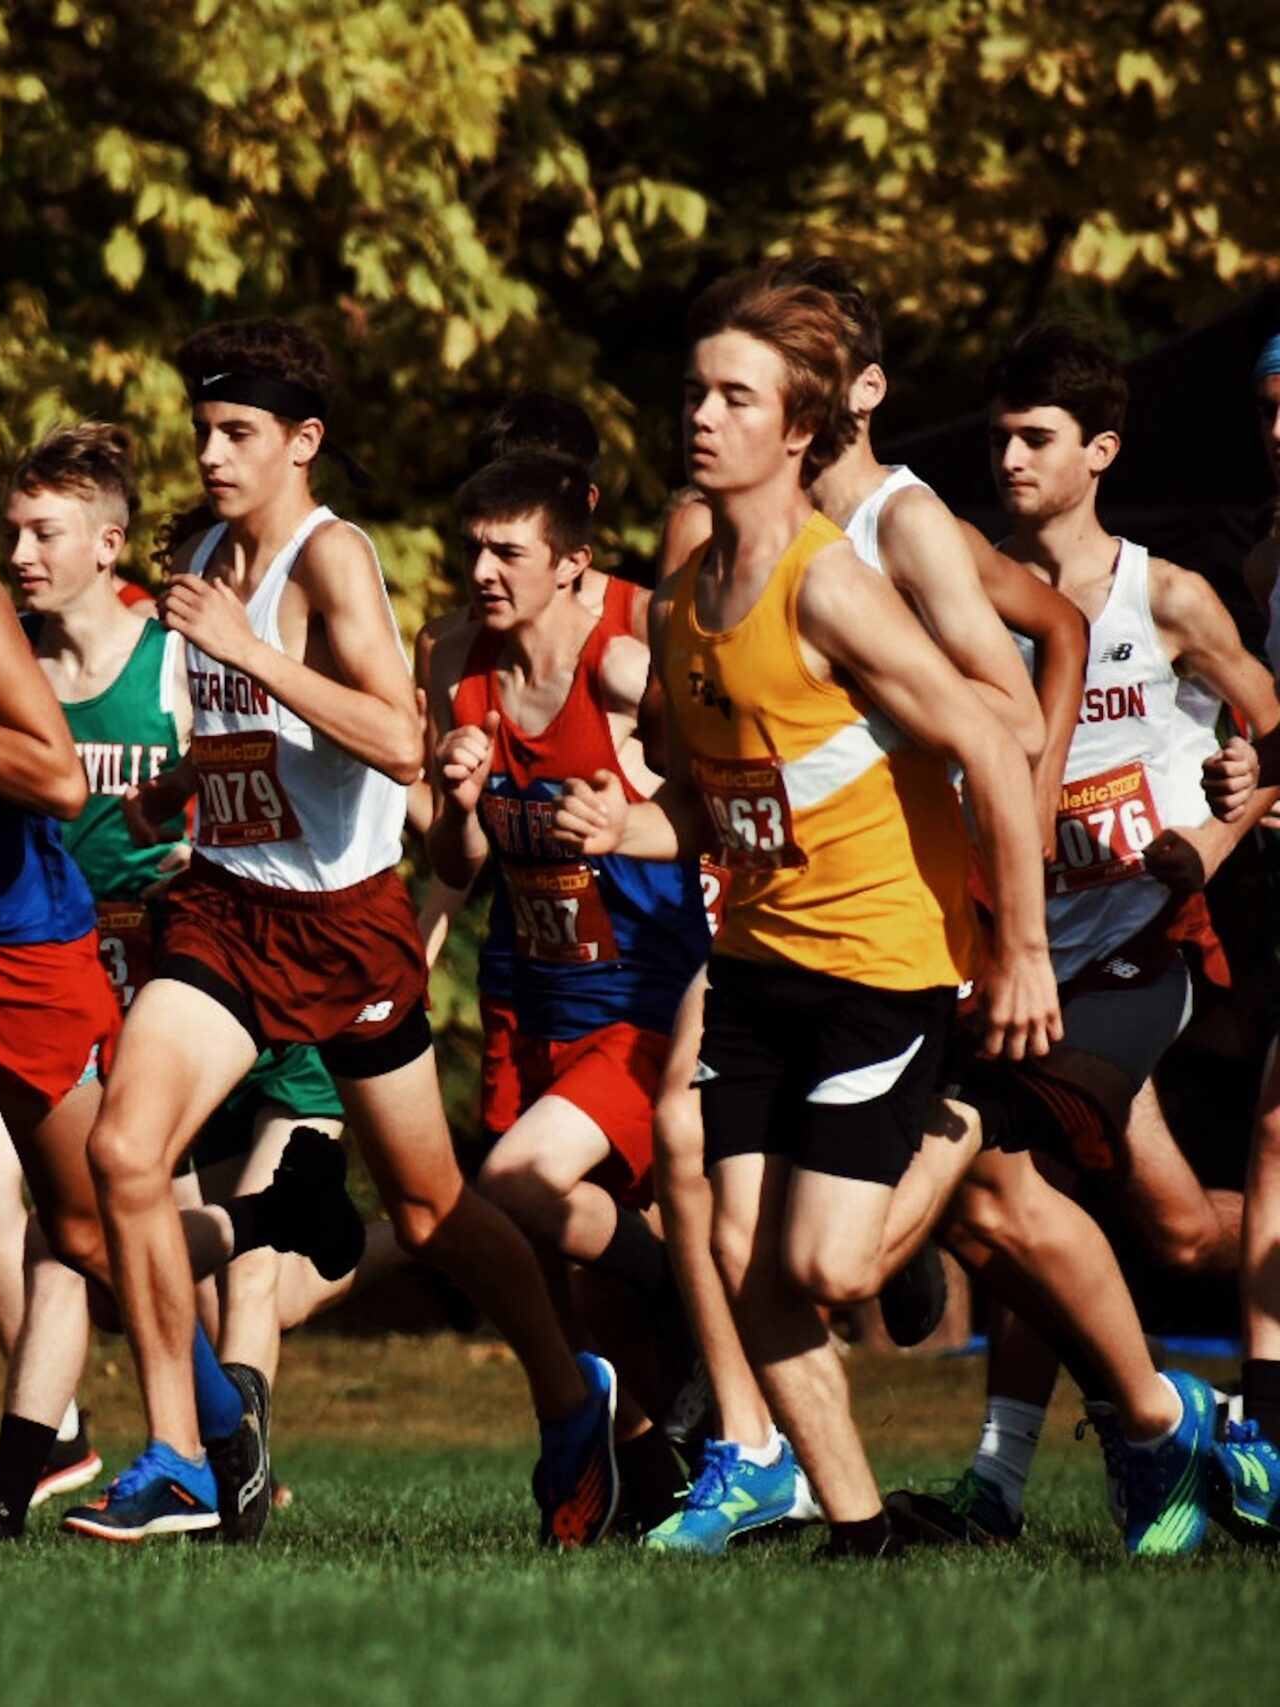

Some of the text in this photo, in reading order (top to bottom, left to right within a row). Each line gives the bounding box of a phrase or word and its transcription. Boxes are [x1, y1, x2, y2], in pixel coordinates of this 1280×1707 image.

[1077, 682, 1146, 722] SON
[74, 742, 168, 794] VILLE
[1048, 800, 1154, 875] 076
